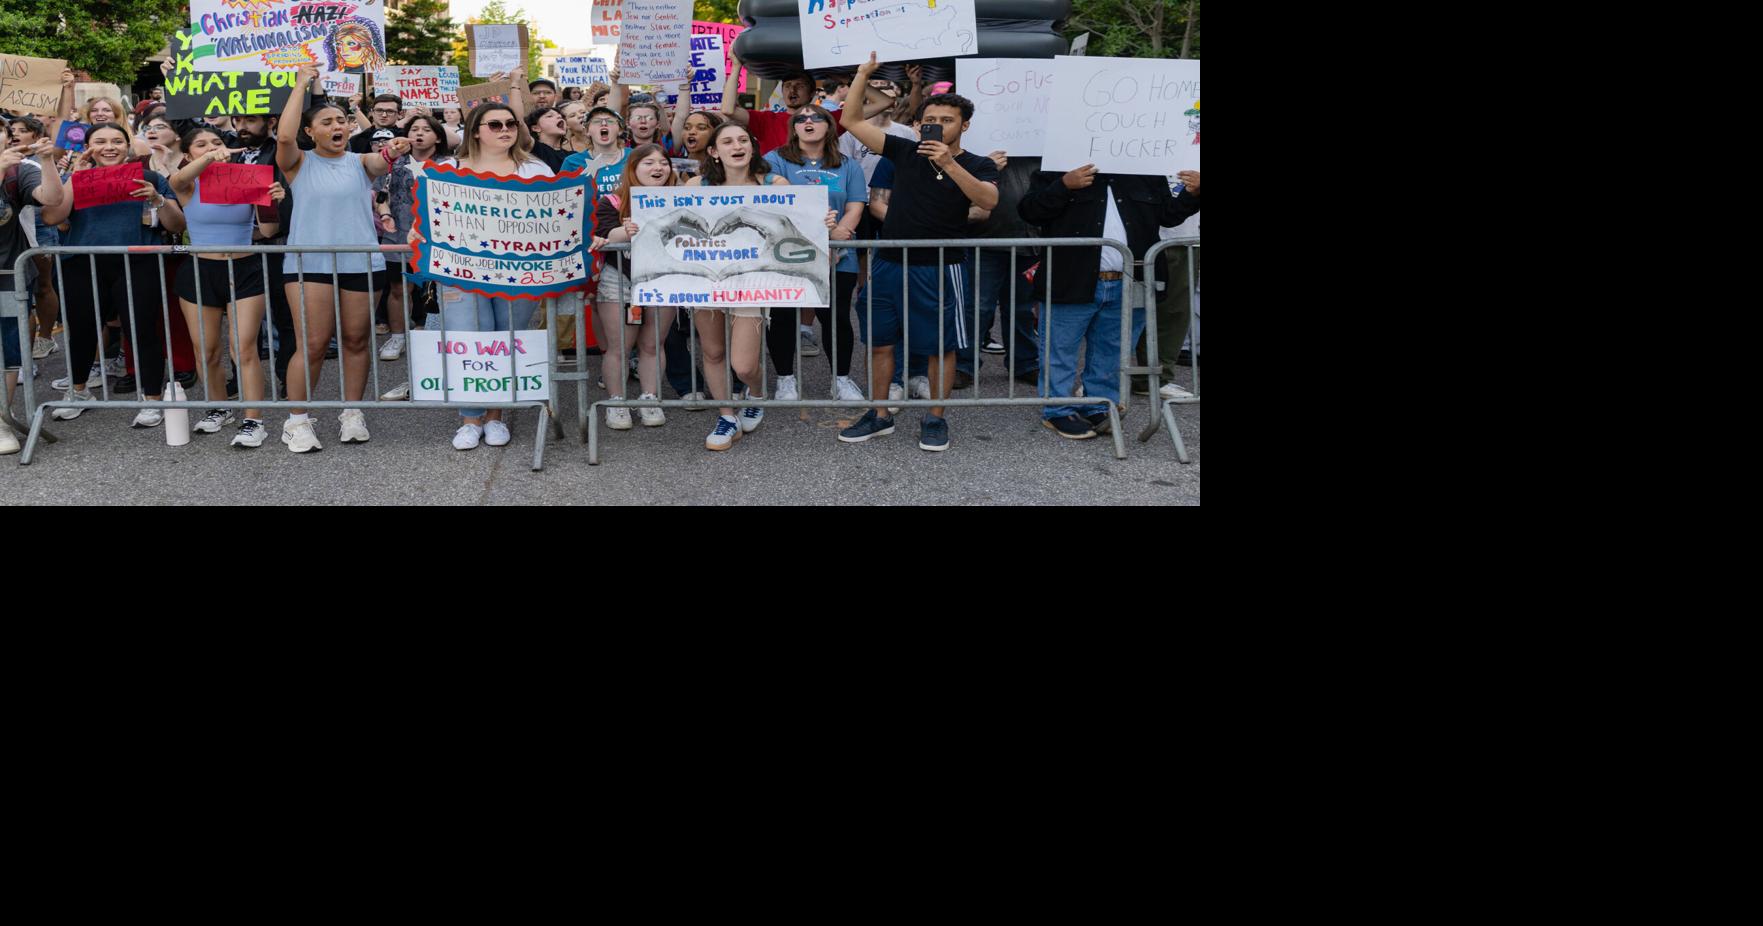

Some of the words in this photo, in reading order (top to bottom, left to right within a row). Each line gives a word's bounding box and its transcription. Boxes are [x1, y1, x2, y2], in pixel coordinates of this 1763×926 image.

[200, 9, 289, 35] Christian
[292, 5, 349, 24] NAZI
[2, 58, 29, 79] NO
[581, 64, 608, 73] RACIST
[165, 71, 244, 96] WHAT
[396, 77, 438, 88] THEIR
[1082, 69, 1138, 108] GO
[1149, 73, 1200, 102] HOME
[204, 89, 271, 115] ARE
[399, 88, 440, 100] NAMES
[1084, 111, 1167, 133] COUCH
[1089, 136, 1178, 158] FUCKER
[602, 174, 621, 183] HOT
[431, 181, 492, 202] NOTHING
[506, 193, 518, 205] IS
[525, 188, 575, 207] MORE
[709, 195, 745, 206] JUST
[752, 193, 796, 205] ABOUT
[453, 202, 554, 219] AMERICAN
[444, 211, 486, 231] THAN
[498, 218, 562, 235] OPPOSING
[459, 232, 468, 247] A
[489, 239, 562, 252] TYRANT
[432, 249, 445, 260] DO
[475, 258, 496, 270] JOB
[495, 260, 553, 272] INVOKE
[558, 256, 577, 267] THE
[682, 247, 760, 262] ANYMORE
[453, 268, 477, 280] J.D.
[668, 292, 711, 304] ABOUT
[712, 287, 806, 303] HUMANITY
[437, 340, 469, 355] NO
[474, 338, 528, 357] WAR
[462, 359, 499, 372] FOR
[420, 376, 455, 392] OIL
[462, 374, 544, 393] PROFITS
